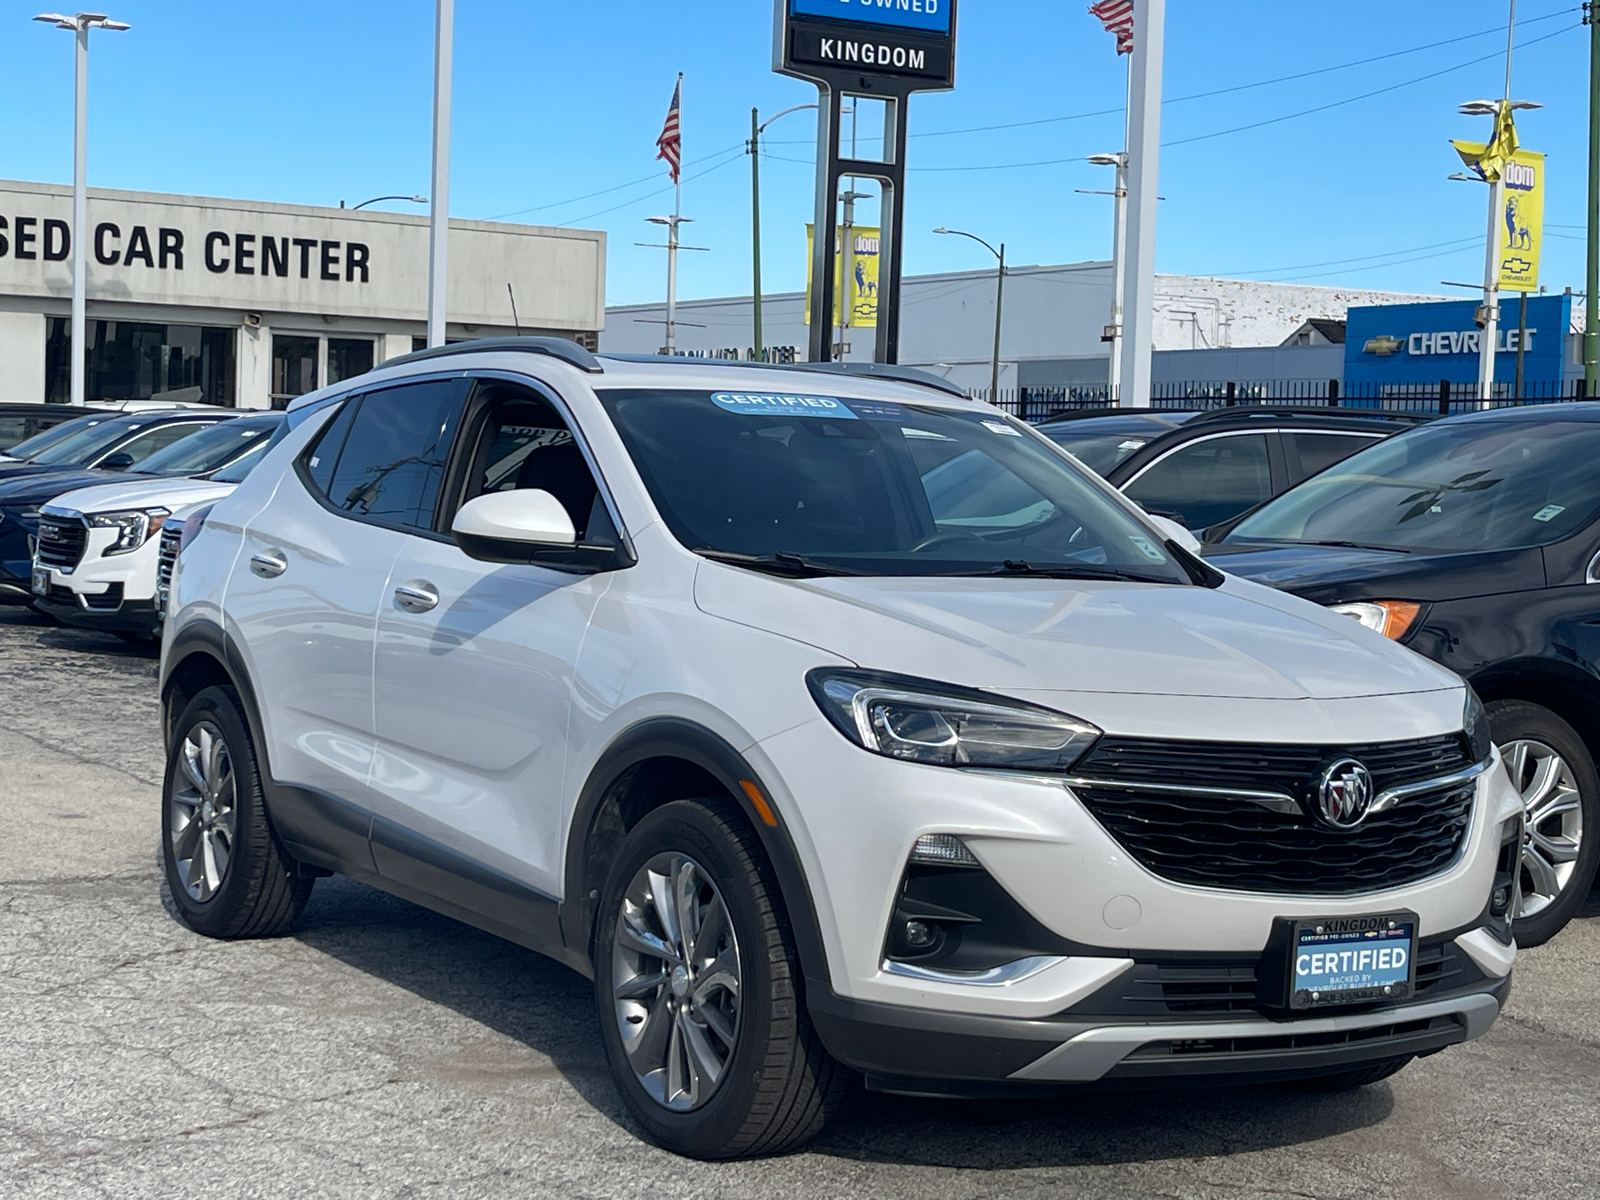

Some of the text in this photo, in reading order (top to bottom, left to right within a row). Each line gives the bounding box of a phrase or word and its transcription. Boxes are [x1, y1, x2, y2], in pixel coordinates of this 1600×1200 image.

[820, 38, 925, 69] KINGDOM
[1505, 160, 1535, 191] dom
[94, 222, 184, 270] CAR
[204, 231, 371, 283] CENTER
[854, 234, 879, 255] dom
[1408, 328, 1537, 356] CHEVRLET
[747, 345, 800, 366] CNTER
[716, 394, 838, 409] CERTIFIED
[1324, 917, 1389, 932] KINGDOM
[1296, 947, 1407, 976] CERTIFIED
[1329, 973, 1372, 985] BACKED BY
